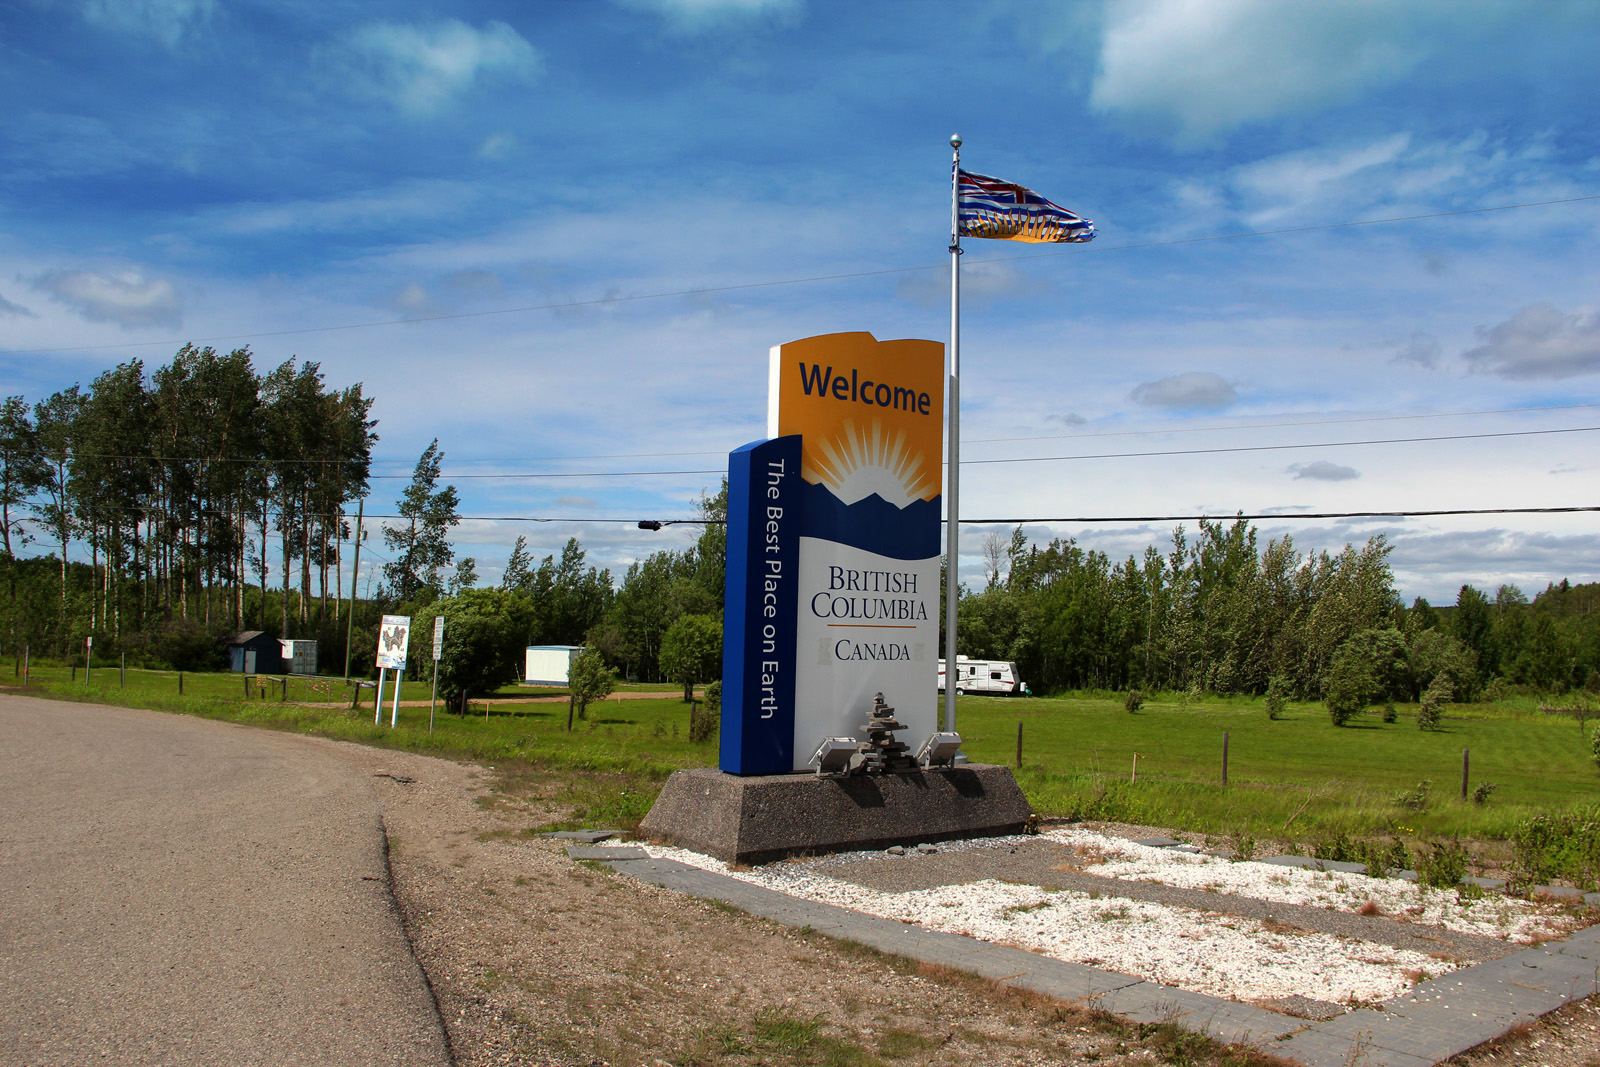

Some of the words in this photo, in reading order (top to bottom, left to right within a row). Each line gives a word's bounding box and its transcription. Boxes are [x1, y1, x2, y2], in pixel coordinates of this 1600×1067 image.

[799, 362, 931, 415] Welcome
[768, 458, 785, 499] The
[765, 506, 783, 553] Best
[763, 560, 782, 618] Place
[828, 566, 918, 593] BRITISH
[811, 592, 928, 620] COLUMBIA
[762, 626, 776, 653] on
[835, 639, 911, 661] CANADA
[761, 661, 779, 719] Earth
